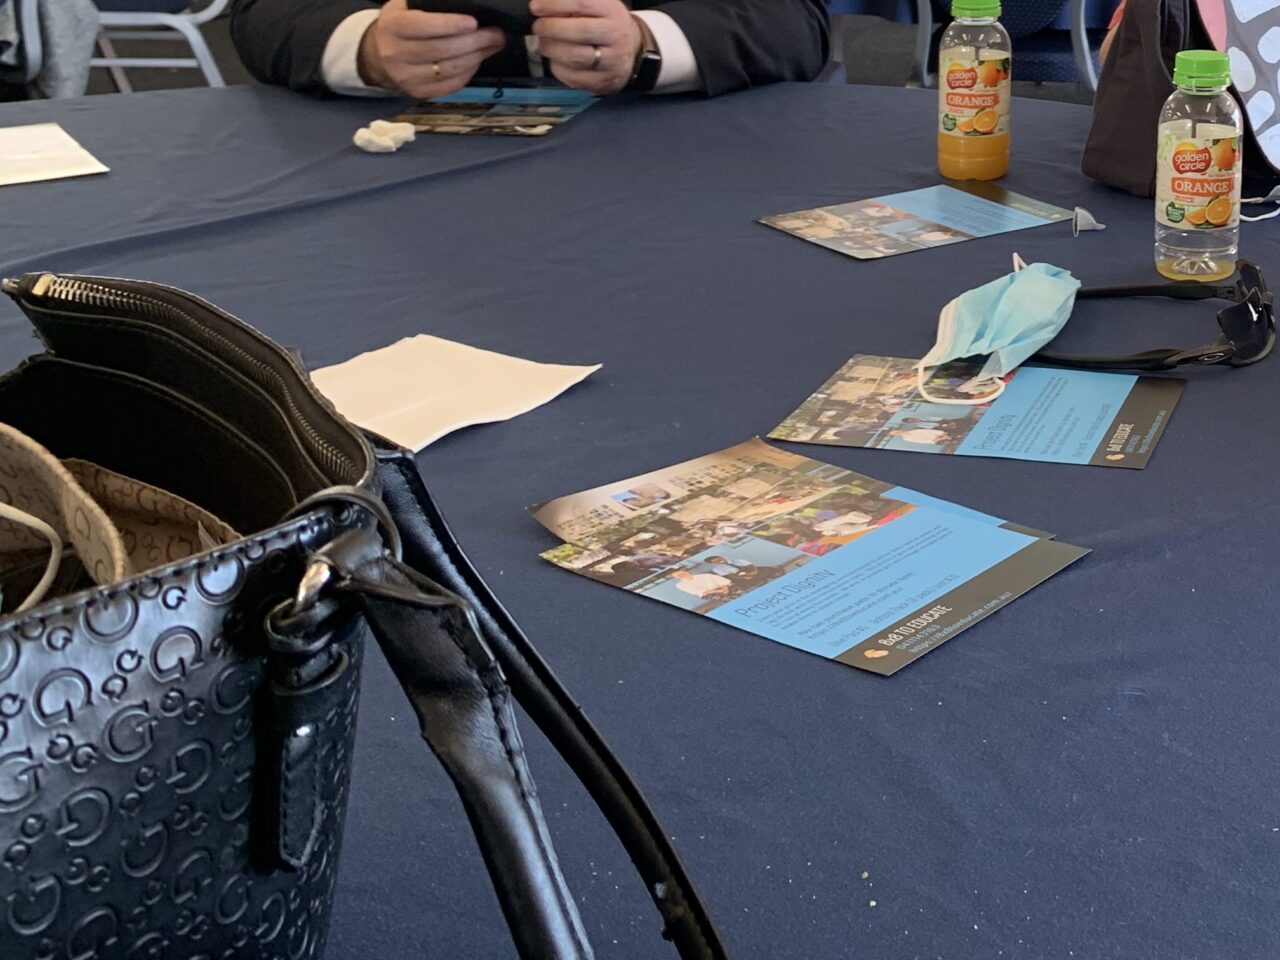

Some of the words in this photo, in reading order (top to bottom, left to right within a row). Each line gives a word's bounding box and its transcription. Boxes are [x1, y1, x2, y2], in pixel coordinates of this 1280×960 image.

[948, 95, 994, 106] ORANGE
[1175, 152, 1209, 164] golden
[1179, 161, 1206, 170] circle
[1174, 180, 1229, 193] ORANGE
[733, 588, 792, 618] Project
[785, 567, 837, 594] Dignity
[876, 632, 905, 646] 8x8
[892, 625, 918, 636] TO
[905, 604, 954, 629] EDUCATE
